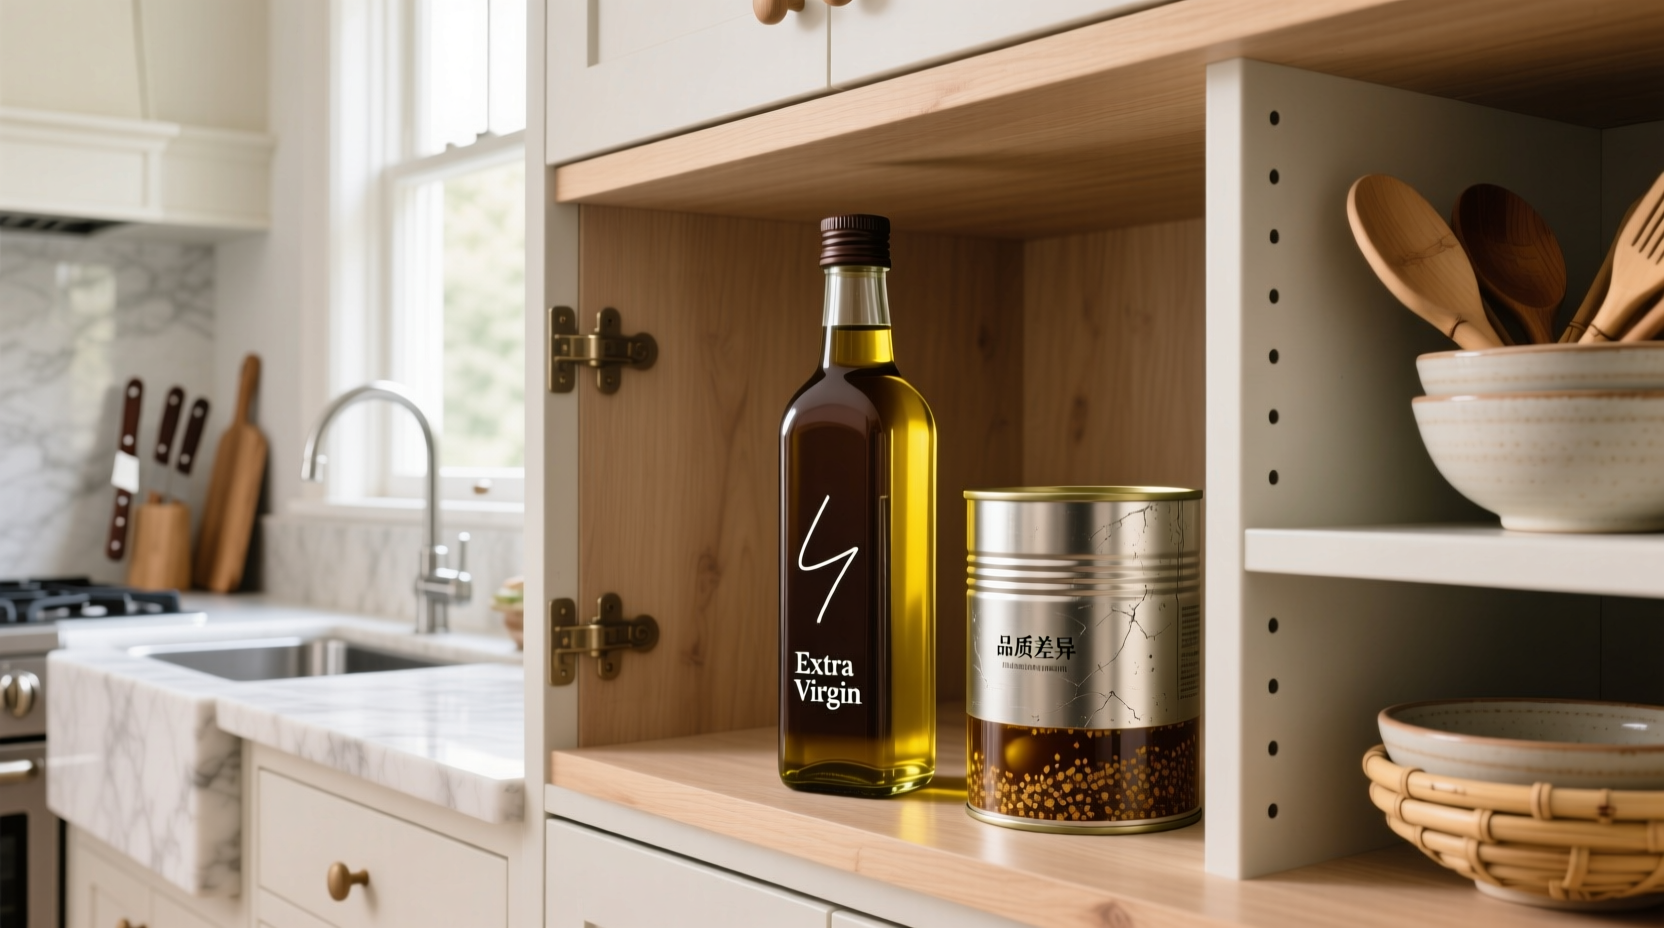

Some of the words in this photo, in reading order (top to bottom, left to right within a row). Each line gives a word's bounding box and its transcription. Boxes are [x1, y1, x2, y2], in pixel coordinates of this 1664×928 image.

[997, 634, 1076, 660] 品质差异
[794, 651, 854, 677] Extra
[793, 679, 863, 711] Virgin
